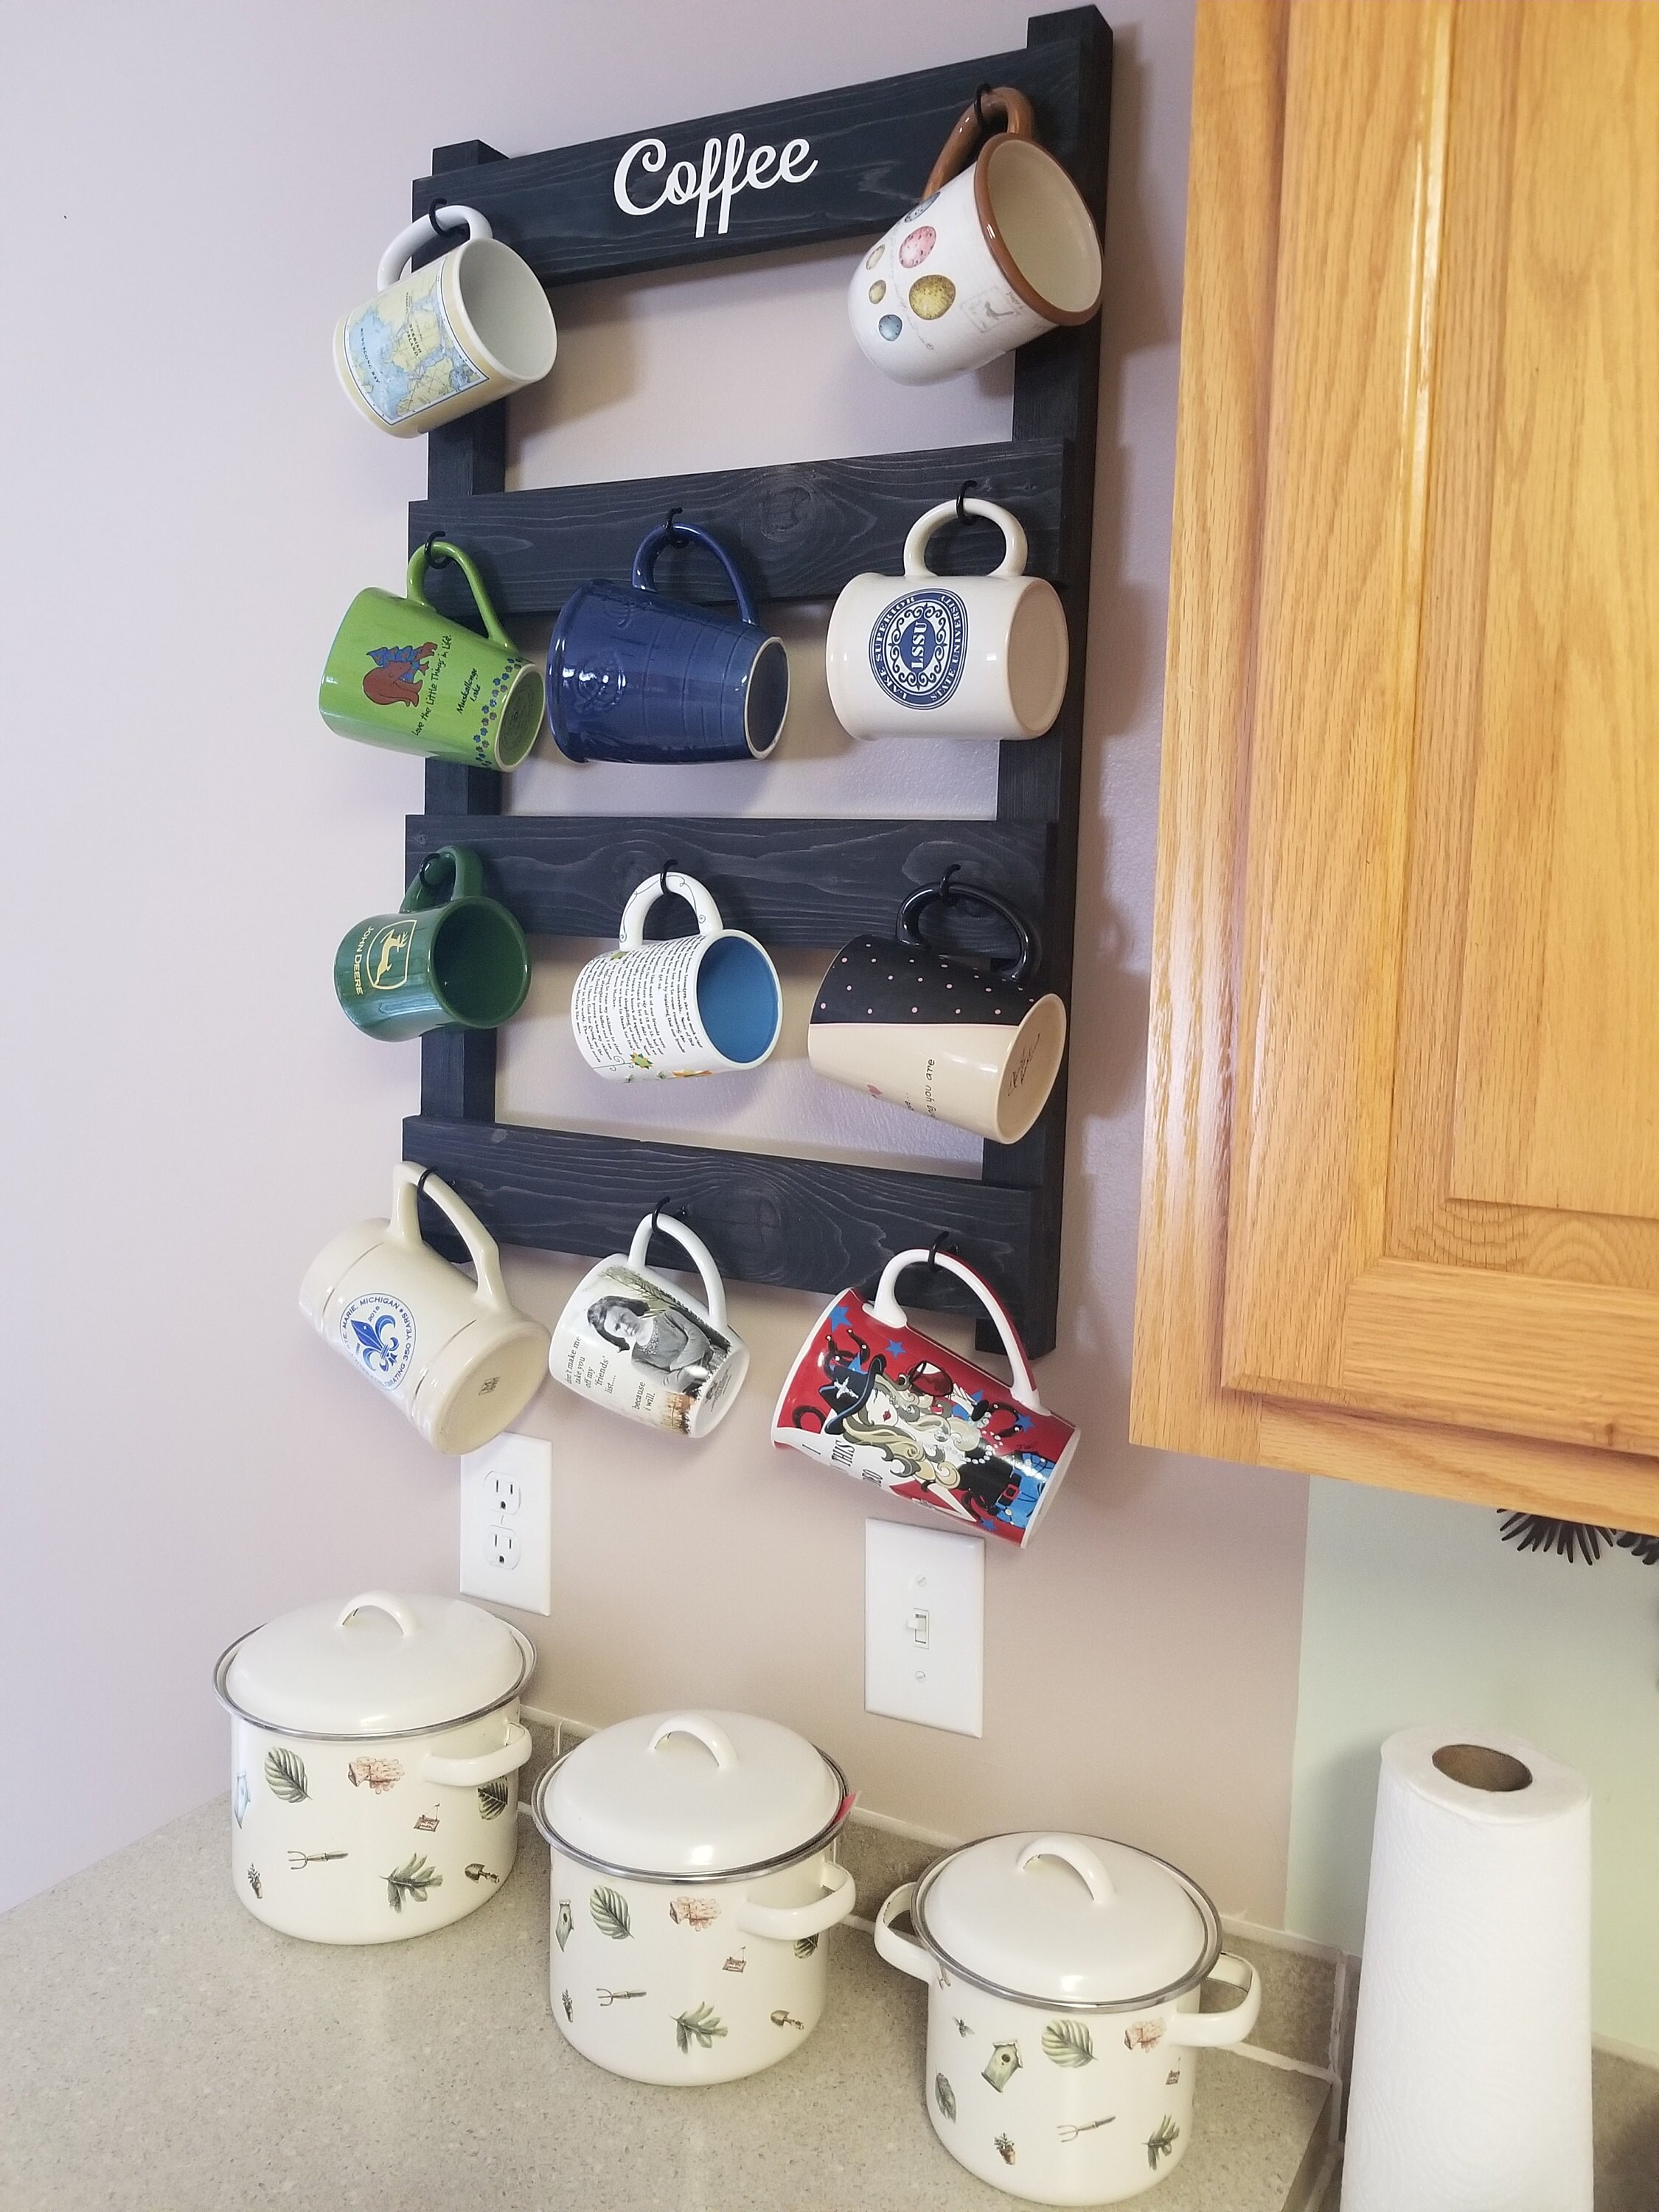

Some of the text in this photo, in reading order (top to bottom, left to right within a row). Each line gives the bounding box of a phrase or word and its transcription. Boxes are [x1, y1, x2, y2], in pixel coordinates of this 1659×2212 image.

[613, 133, 819, 238] Coffee
[874, 596, 915, 700] LAKE SUPERIOR
[911, 622, 928, 669] LSSU
[931, 595, 962, 701] STATE UNIVERSITY
[431, 658, 446, 681] Things
[425, 683, 437, 706] Little
[470, 684, 481, 703] Lake
[420, 706, 431, 721] the
[411, 722, 424, 736] Love
[353, 925, 375, 995] JOHN DEERE
[926, 1059, 935, 1081] are
[925, 1085, 935, 1102] you
[343, 1304, 359, 1329] MARIE,
[360, 1296, 400, 1310] MICHIGAN
[401, 1312, 412, 1340] YEARS
[403, 1343, 411, 1361] 350
[567, 1349, 577, 1370] make
[573, 1336, 582, 1349] me
[574, 1356, 585, 1385] take you
[583, 1366, 596, 1388] off my
[632, 1381, 646, 1410] because
[646, 1392, 655, 1407] will.
[831, 1439, 855, 1467] THIS
